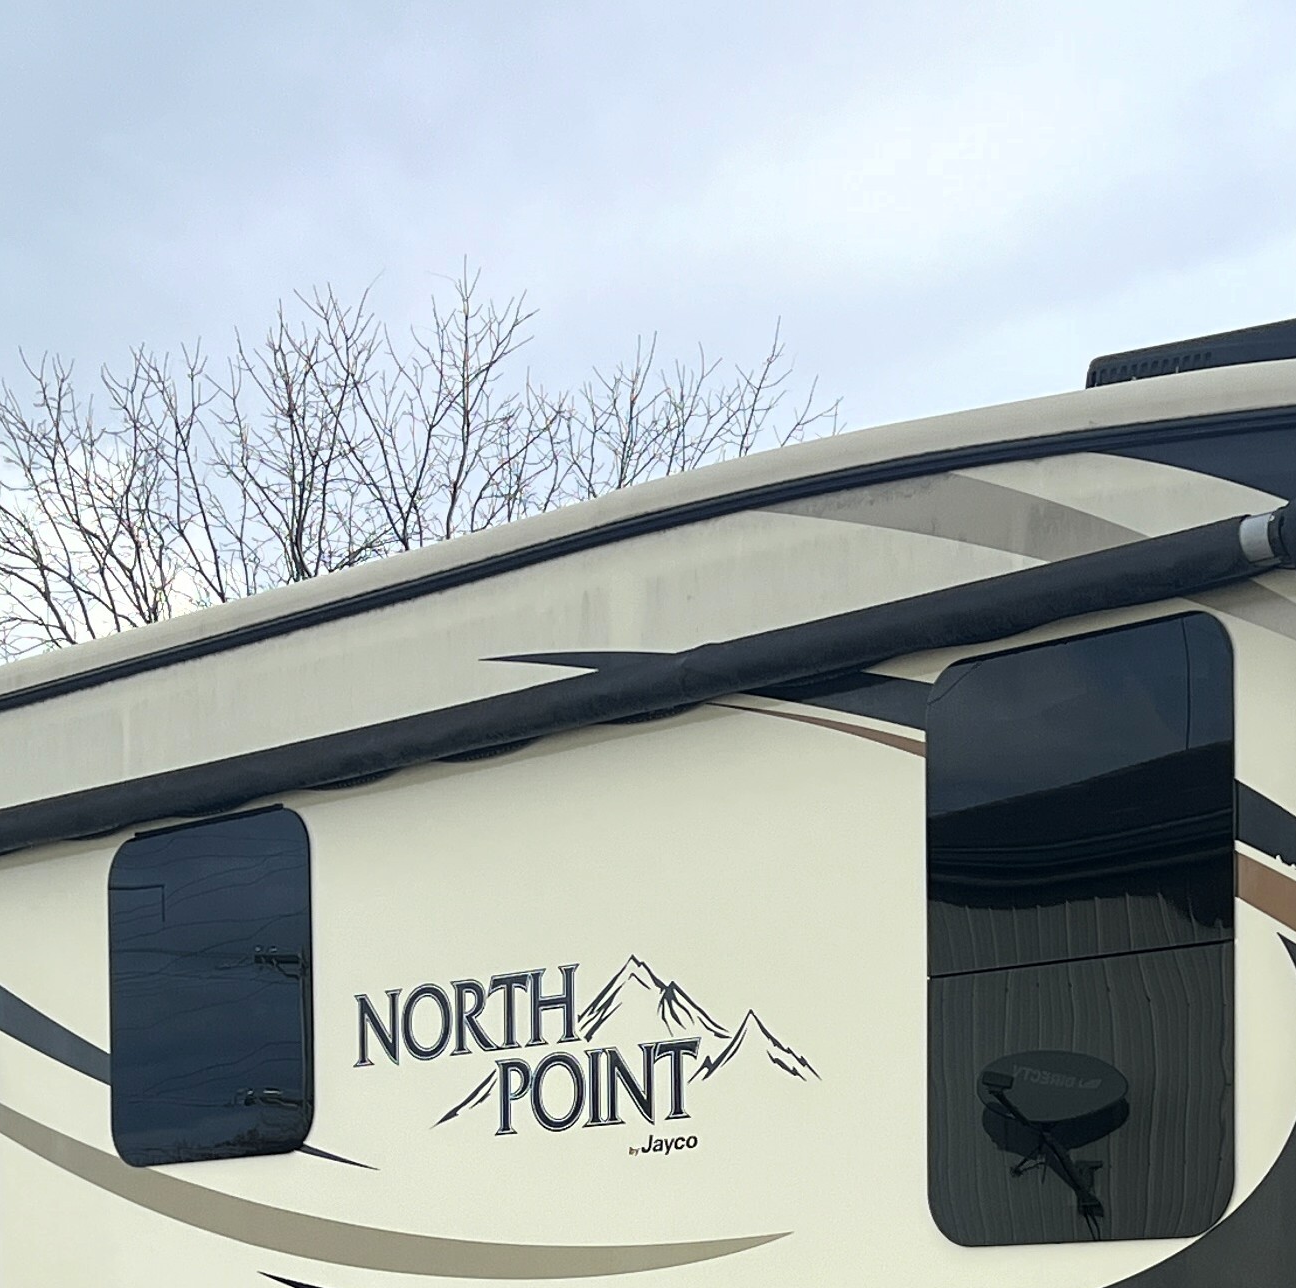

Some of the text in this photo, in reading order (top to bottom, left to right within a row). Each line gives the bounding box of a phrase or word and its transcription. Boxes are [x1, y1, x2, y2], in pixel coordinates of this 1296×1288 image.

[353, 962, 581, 1068] NORTH
[494, 1036, 702, 1136] POINT
[641, 1134, 698, 1156] Jayco
